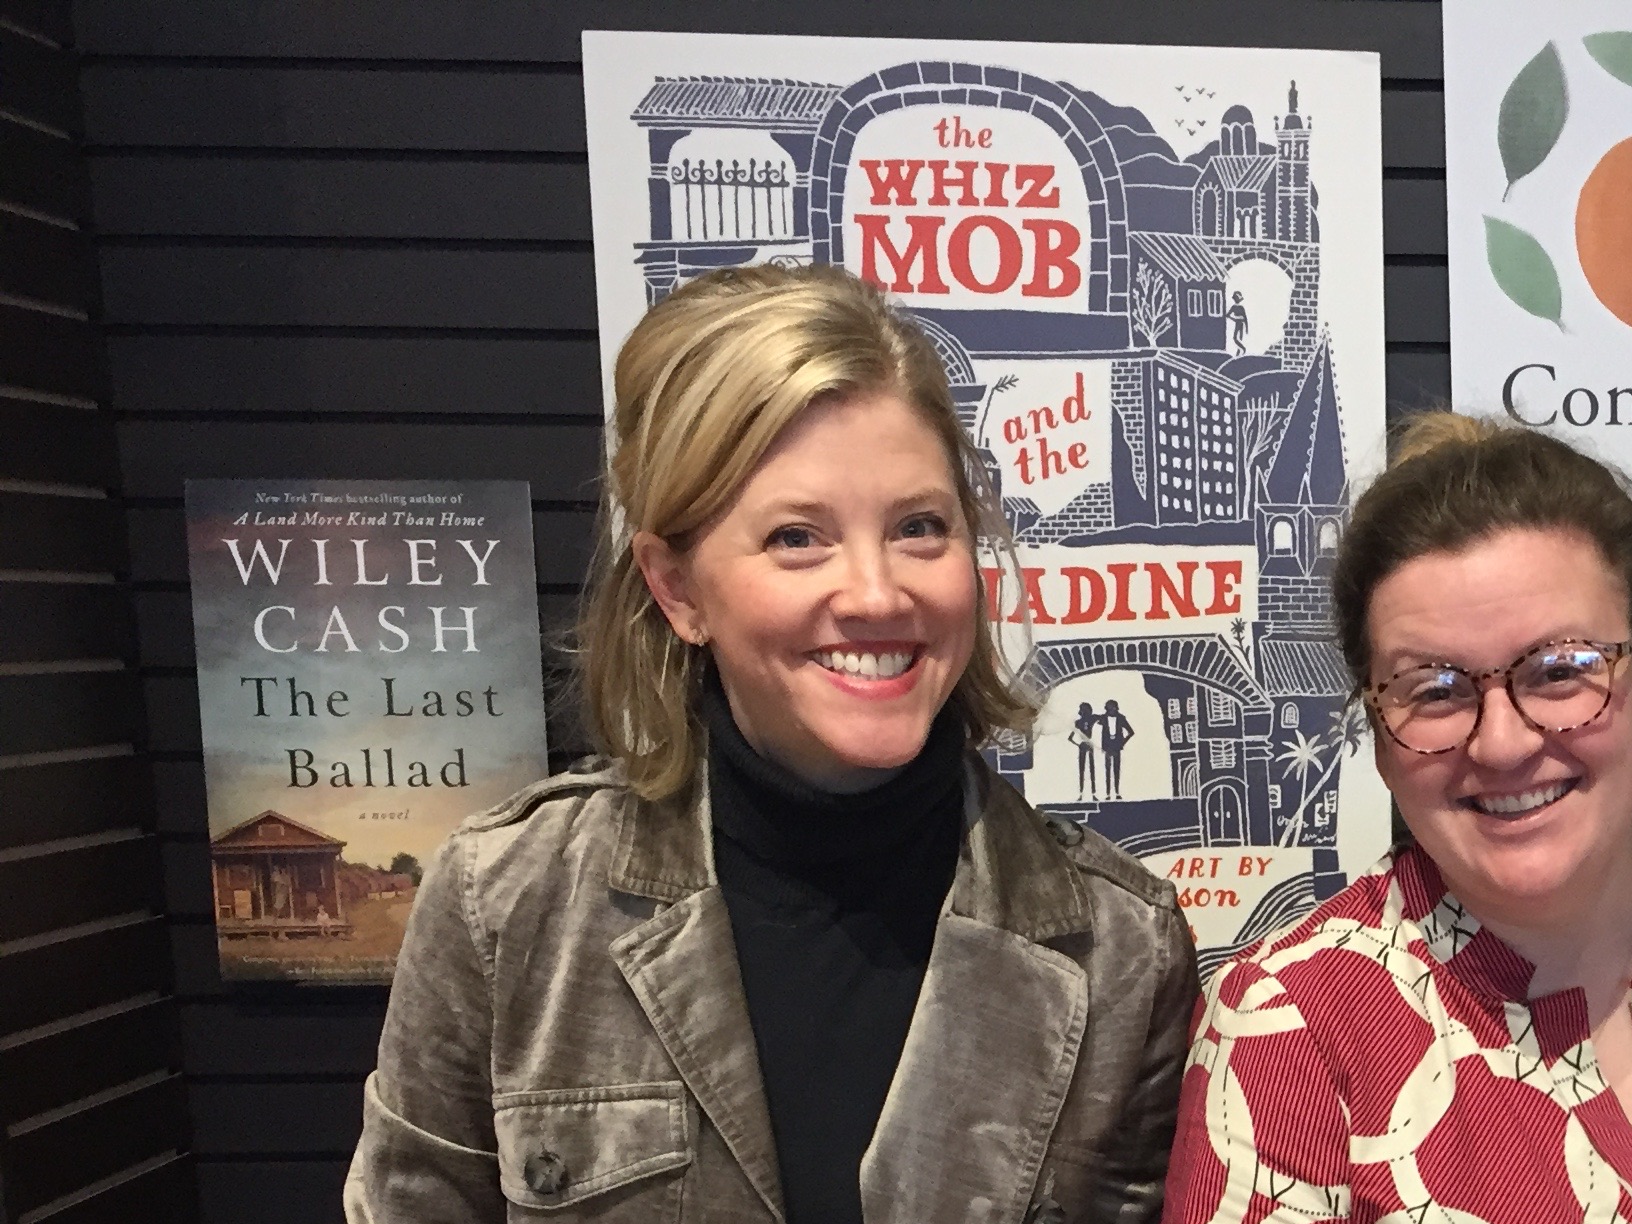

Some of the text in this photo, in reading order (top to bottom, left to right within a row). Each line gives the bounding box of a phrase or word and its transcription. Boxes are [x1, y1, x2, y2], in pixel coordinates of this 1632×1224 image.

[933, 116, 994, 150] the
[858, 158, 1060, 209] WHIZ
[854, 213, 1083, 298] MOB
[1002, 372, 1092, 445] and
[1015, 436, 1089, 486] the
[233, 512, 486, 527] A Land More Kind Than Home
[346, 493, 407, 506] bestselling
[410, 493, 448, 504] author
[450, 493, 464, 504] of
[222, 538, 501, 587] WILEY
[253, 605, 480, 653] CASH
[240, 676, 504, 718] The Last
[286, 748, 471, 788] Ballad
[359, 808, 411, 821] a novel
[1166, 855, 1273, 878] ART BY
